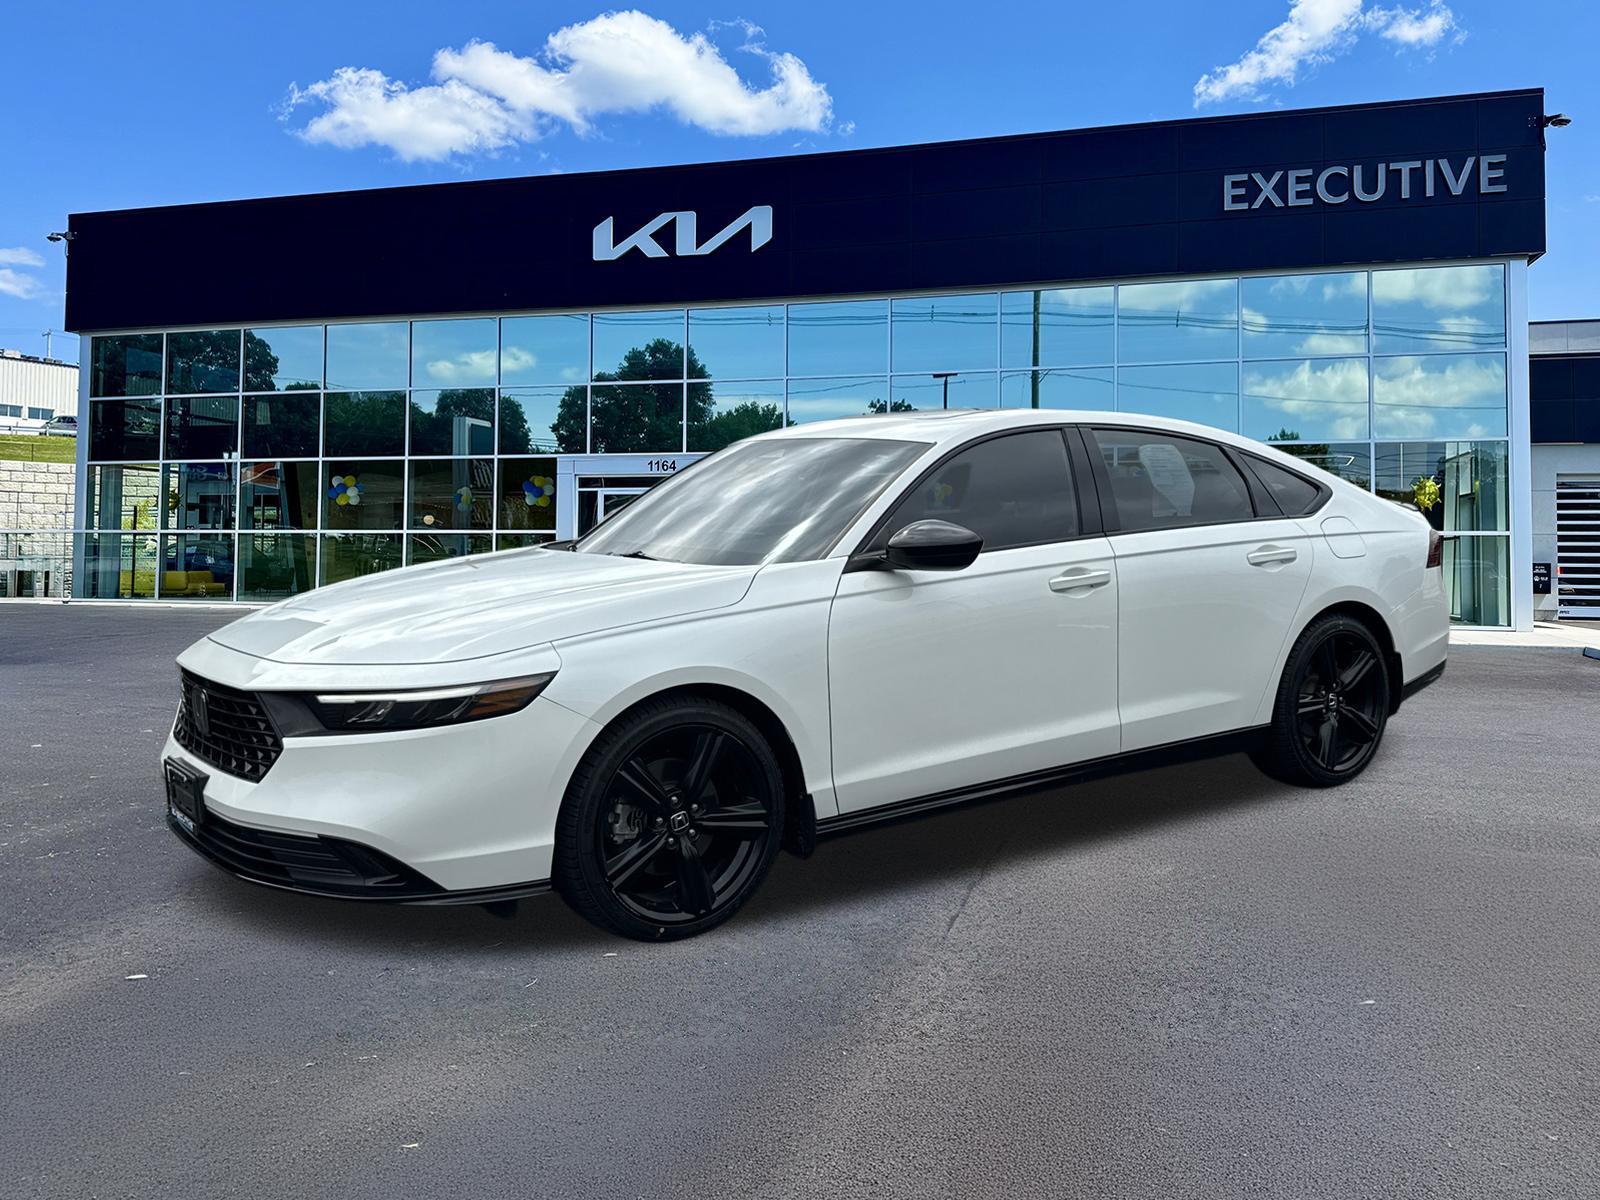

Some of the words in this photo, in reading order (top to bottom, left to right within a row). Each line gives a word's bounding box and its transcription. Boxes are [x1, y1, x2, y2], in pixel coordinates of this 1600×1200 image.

[1223, 154, 1508, 211] EXECUTIVE
[593, 205, 773, 261] KIA
[647, 459, 677, 472] 1164
